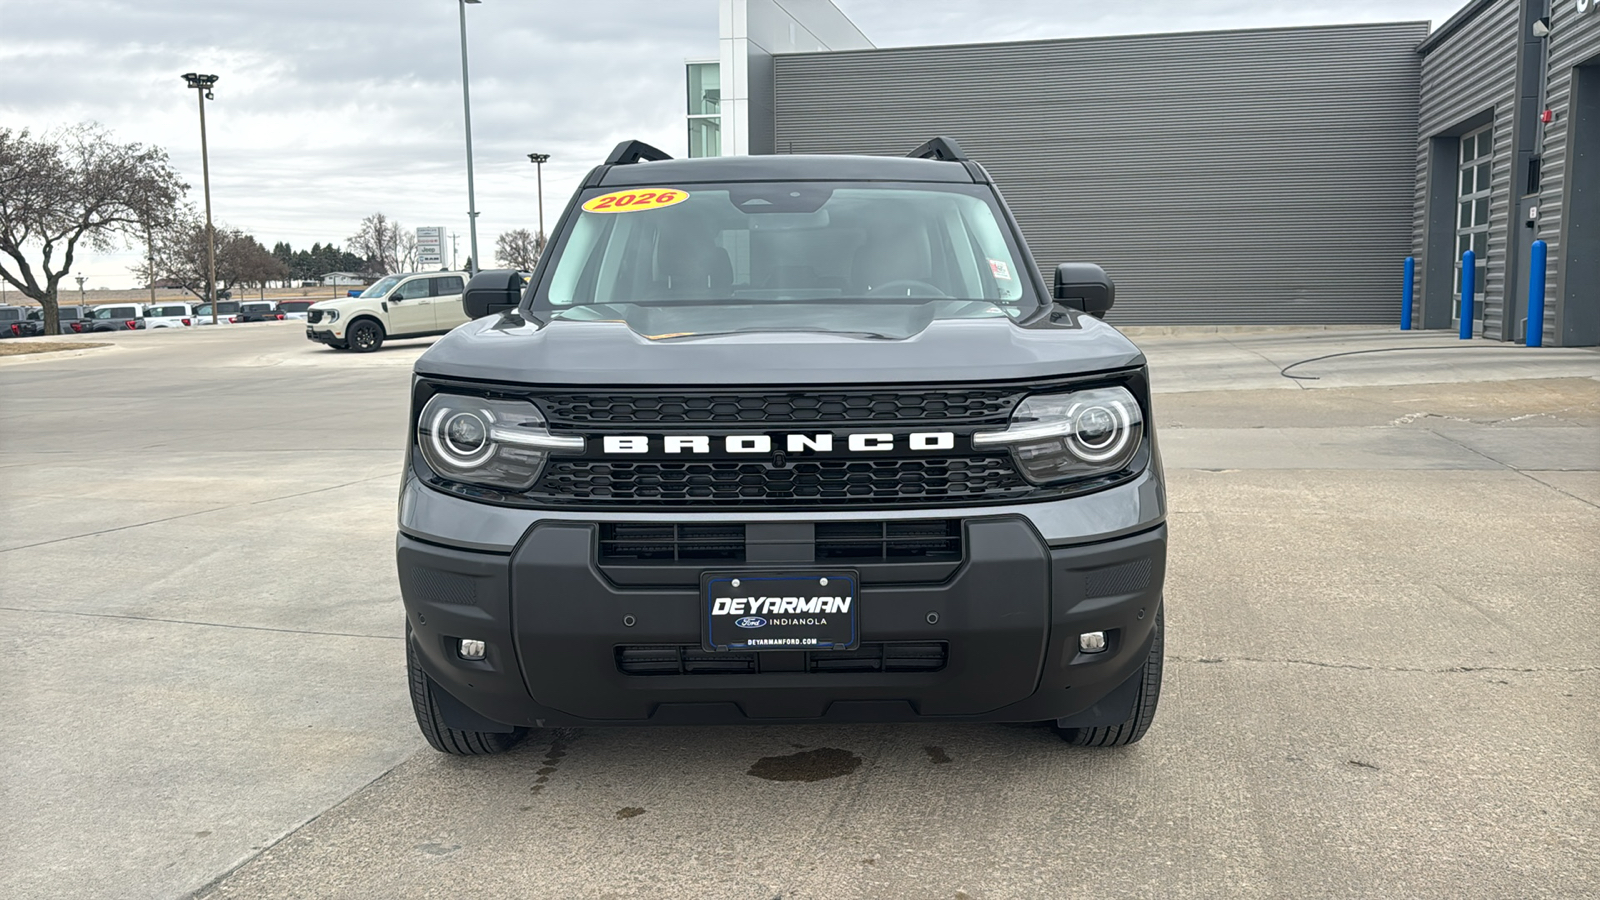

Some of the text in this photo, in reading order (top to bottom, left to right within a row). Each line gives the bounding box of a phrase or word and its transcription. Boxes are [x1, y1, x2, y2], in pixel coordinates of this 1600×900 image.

[592, 191, 678, 210] 2026
[603, 432, 955, 453] BRONCO
[711, 596, 852, 615] DEYARMAN
[769, 618, 828, 626] INDIANOLA
[747, 638, 817, 646] DEYARMANFORD.COM
